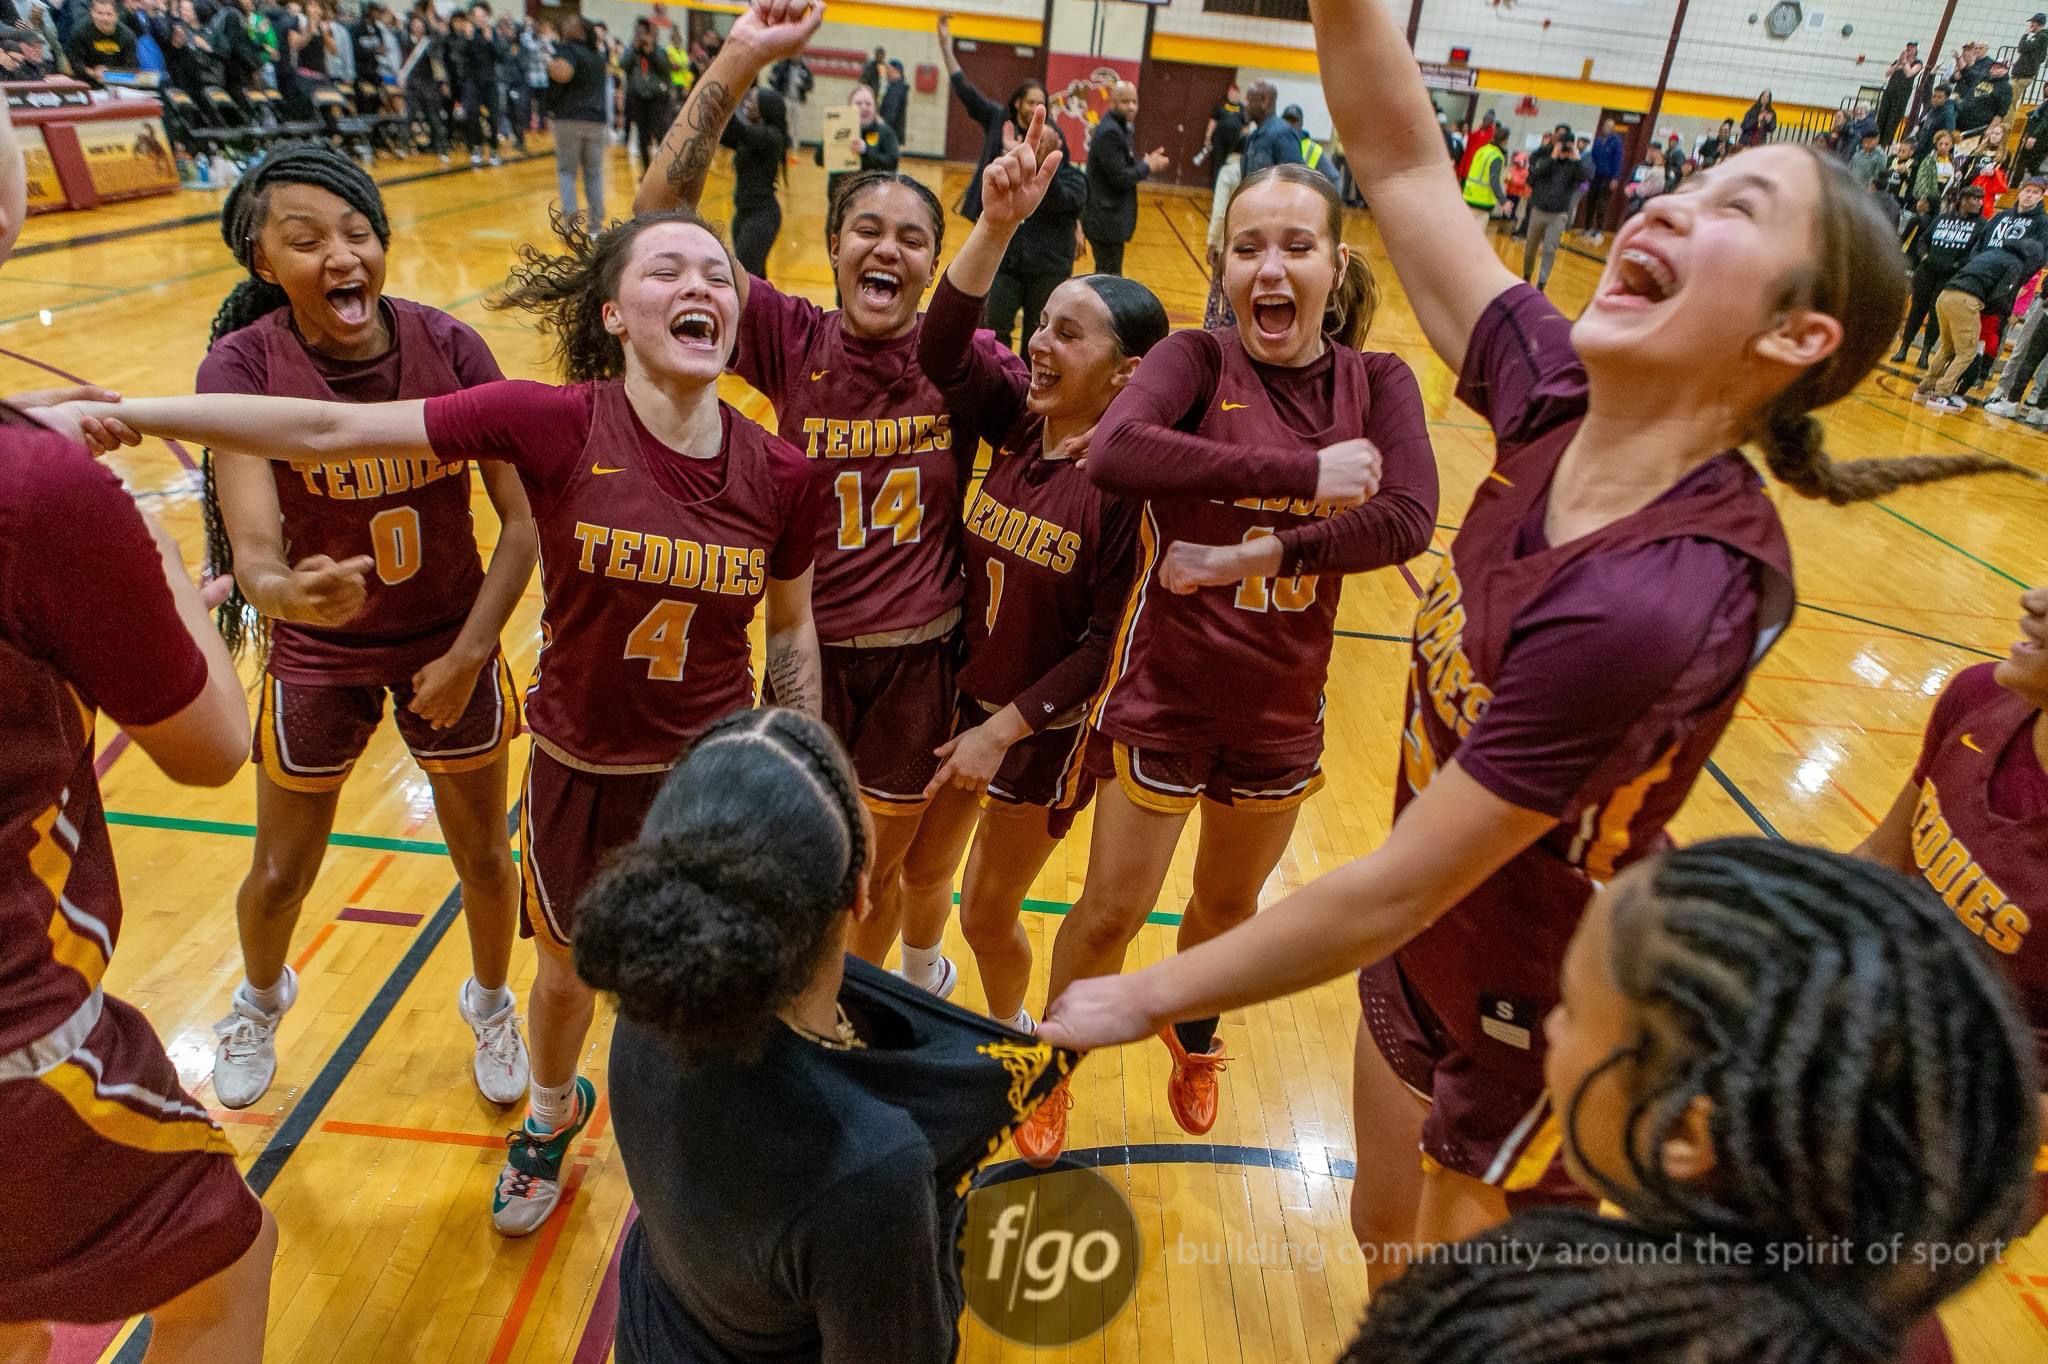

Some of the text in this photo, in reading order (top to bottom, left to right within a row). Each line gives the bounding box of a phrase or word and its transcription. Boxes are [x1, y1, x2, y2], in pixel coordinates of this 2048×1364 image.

[803, 415, 953, 458] TEDDIES
[369, 506, 422, 585] 0
[834, 467, 925, 550] 14
[966, 489, 1082, 575] EDDIES
[574, 521, 765, 596] TEDDIES
[624, 599, 698, 682] 4
